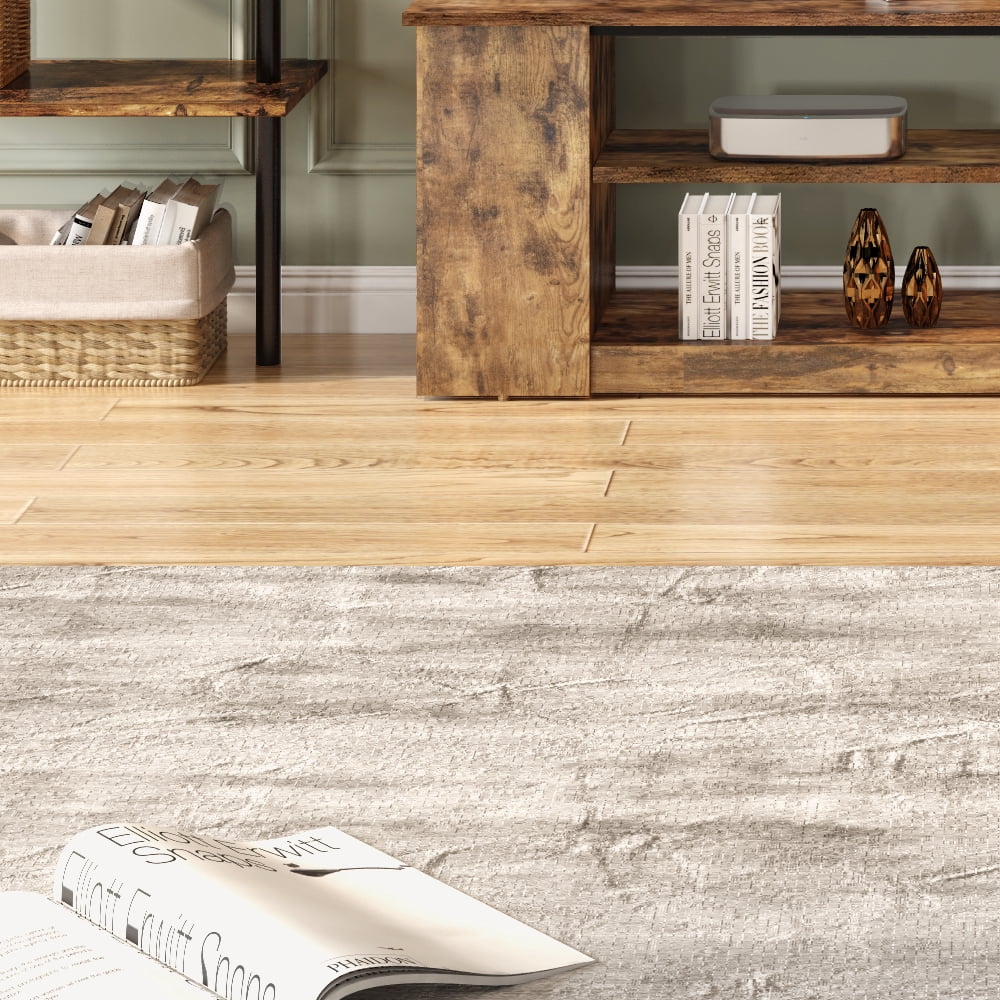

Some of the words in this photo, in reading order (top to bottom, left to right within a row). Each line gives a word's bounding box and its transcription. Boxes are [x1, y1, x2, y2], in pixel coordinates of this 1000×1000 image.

[702, 229, 722, 268] Snaps
[702, 271, 721, 303] Erwitt
[752, 256, 769, 310] FASHION
[702, 307, 721, 338] Elliott
[752, 313, 769, 340] THE
[96, 825, 221, 850] Elliott
[212, 835, 342, 859] Erwitt
[132, 845, 278, 873] Snaps
